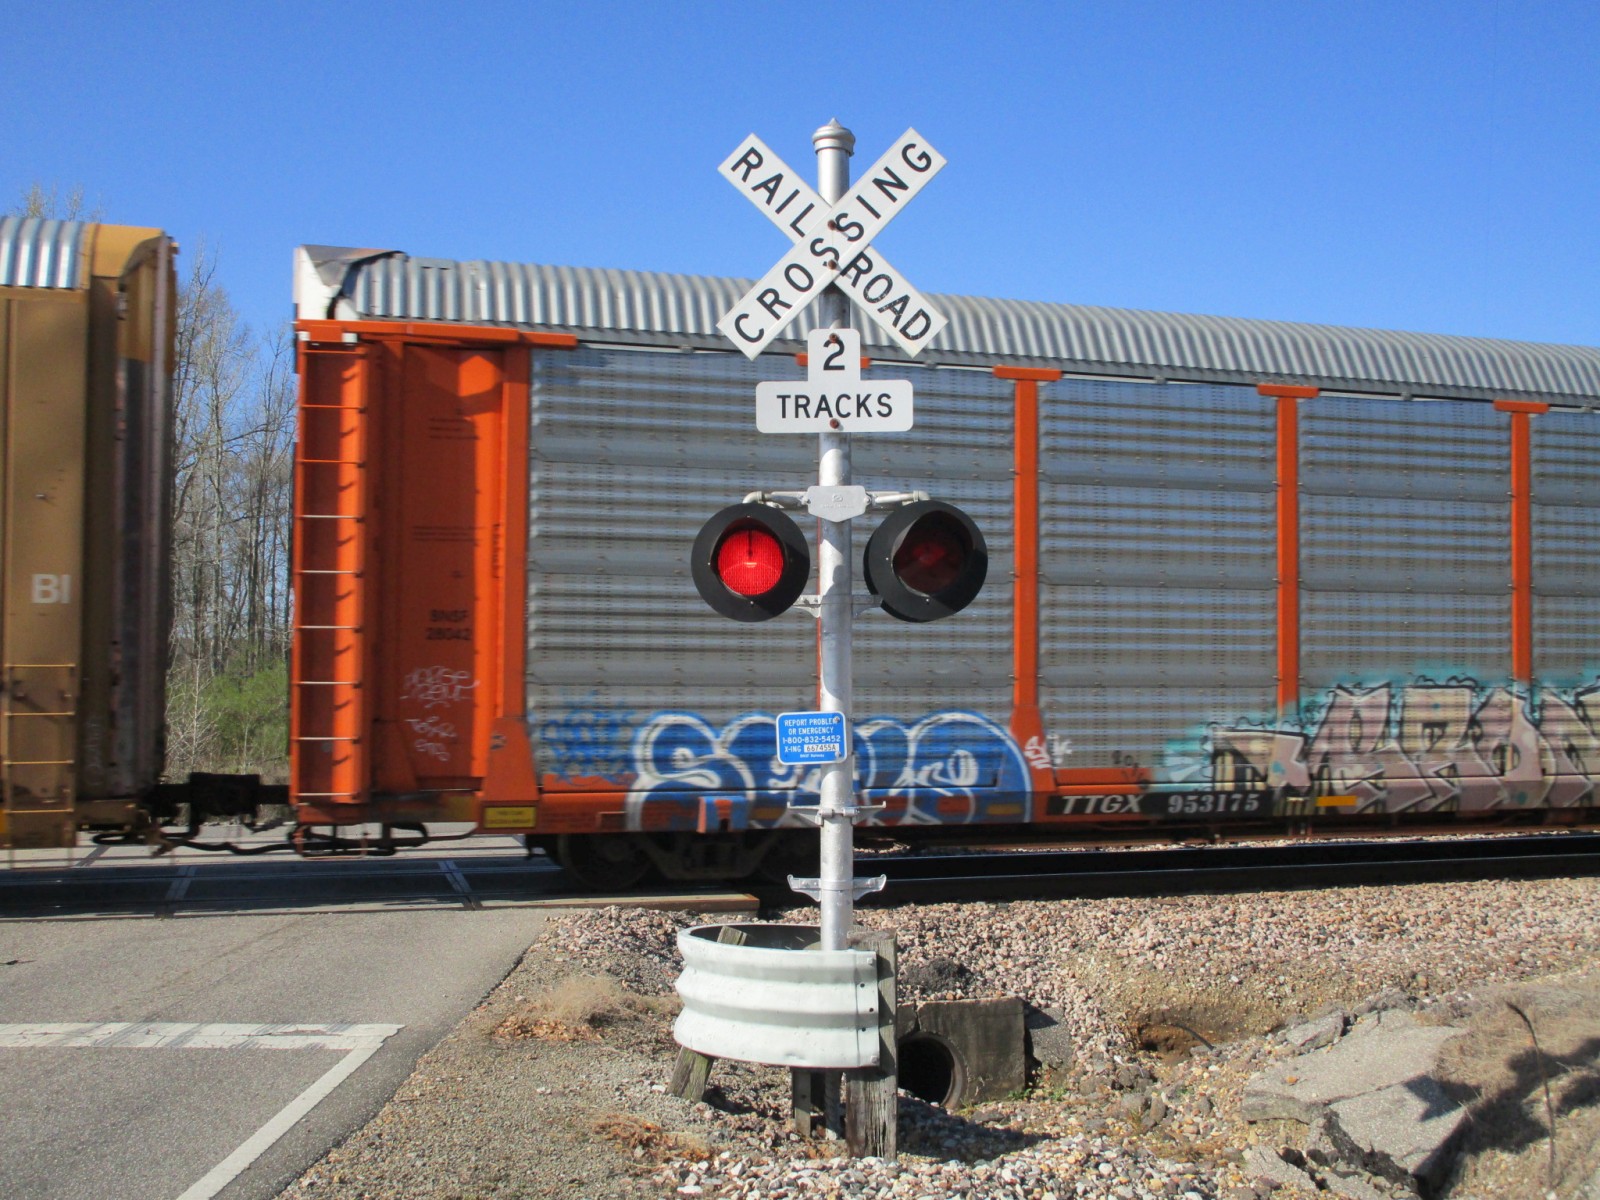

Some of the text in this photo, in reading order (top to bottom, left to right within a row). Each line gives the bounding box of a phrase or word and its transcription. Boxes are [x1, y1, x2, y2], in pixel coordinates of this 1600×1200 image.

[731, 146, 932, 341] RAIL ROAD
[734, 143, 932, 343] CROSSING
[823, 339, 845, 371] 2
[776, 393, 893, 419] TRACKS
[32, 573, 72, 604] BI
[784, 719, 808, 727] REPORT
[798, 727, 834, 735] EMERGENCY
[783, 735, 841, 744] 1-800-832-5452
[1061, 794, 1260, 814] TTGX 953175
